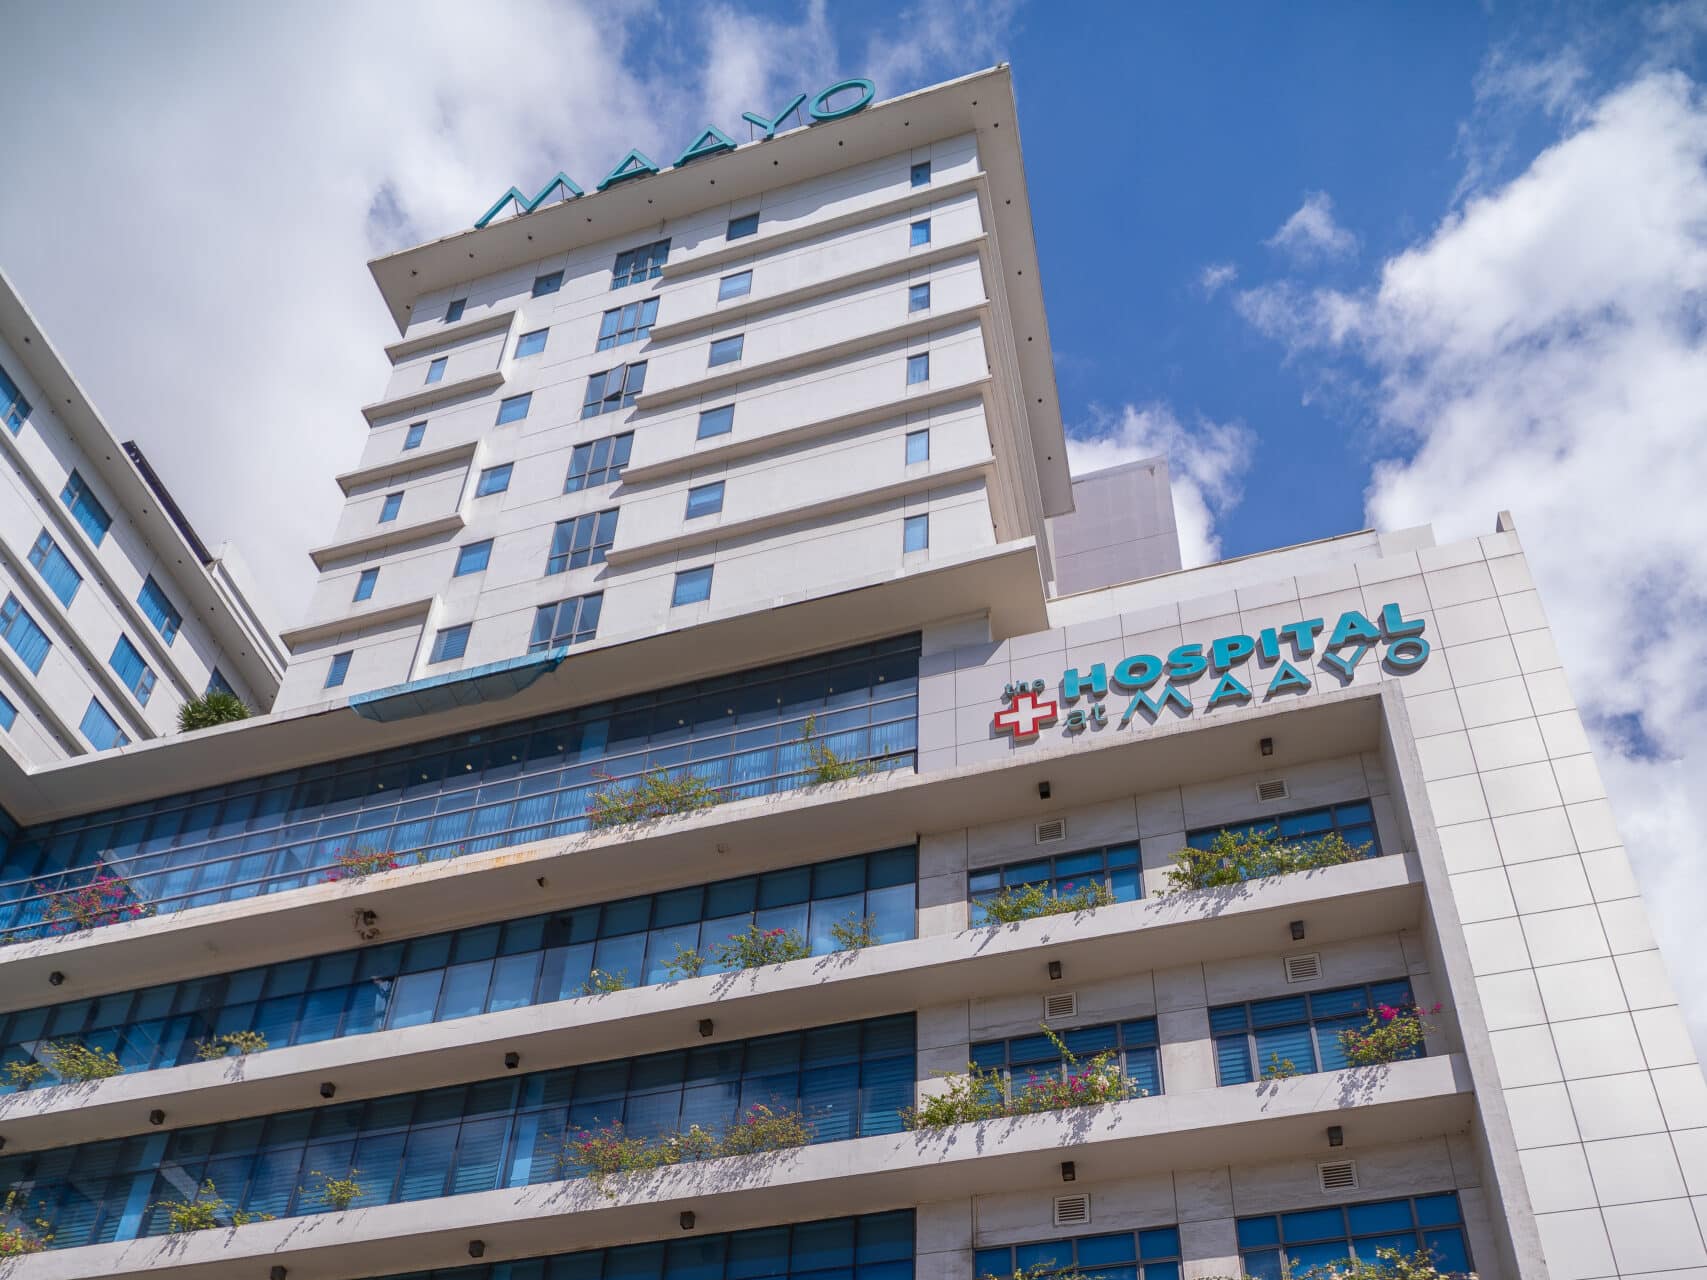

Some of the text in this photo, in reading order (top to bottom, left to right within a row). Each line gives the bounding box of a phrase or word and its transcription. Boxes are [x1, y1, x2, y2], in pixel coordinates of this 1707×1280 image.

[475, 78, 875, 230] MAAYO
[1004, 680, 1045, 695] the
[1064, 603, 1425, 699] HOSPITAL
[1067, 636, 1430, 728] at MAAYO
